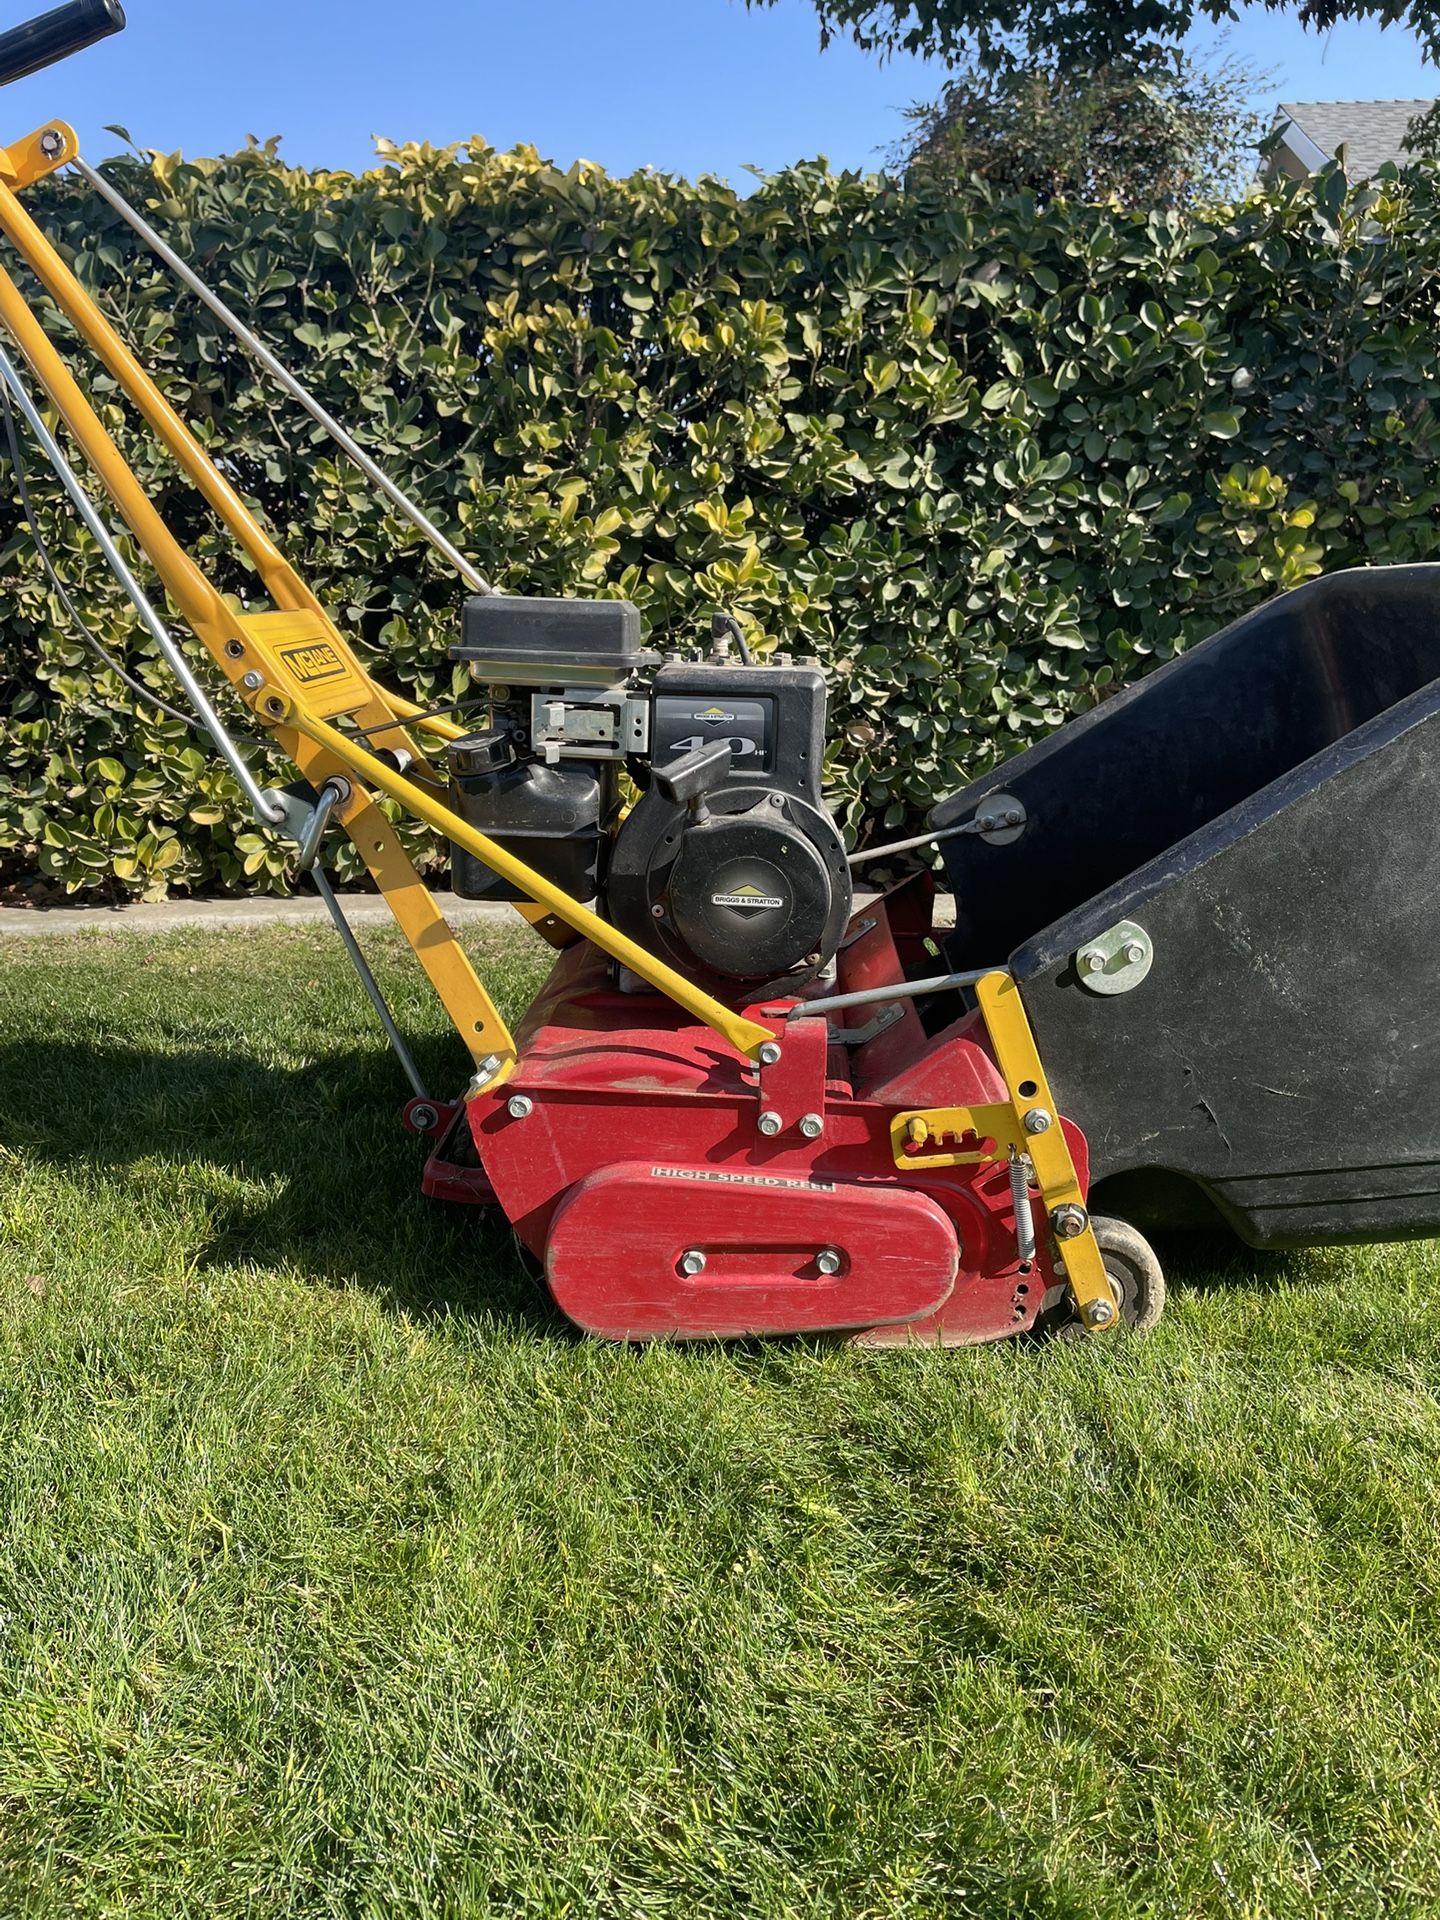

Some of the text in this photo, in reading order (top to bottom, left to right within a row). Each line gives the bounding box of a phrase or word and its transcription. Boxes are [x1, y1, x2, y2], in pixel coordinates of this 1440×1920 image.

[715, 896, 740, 904] BRIGGS
[747, 897, 780, 905] STRATTON
[655, 1168, 710, 1180] HIGH
[718, 1174, 779, 1186] SPEED
